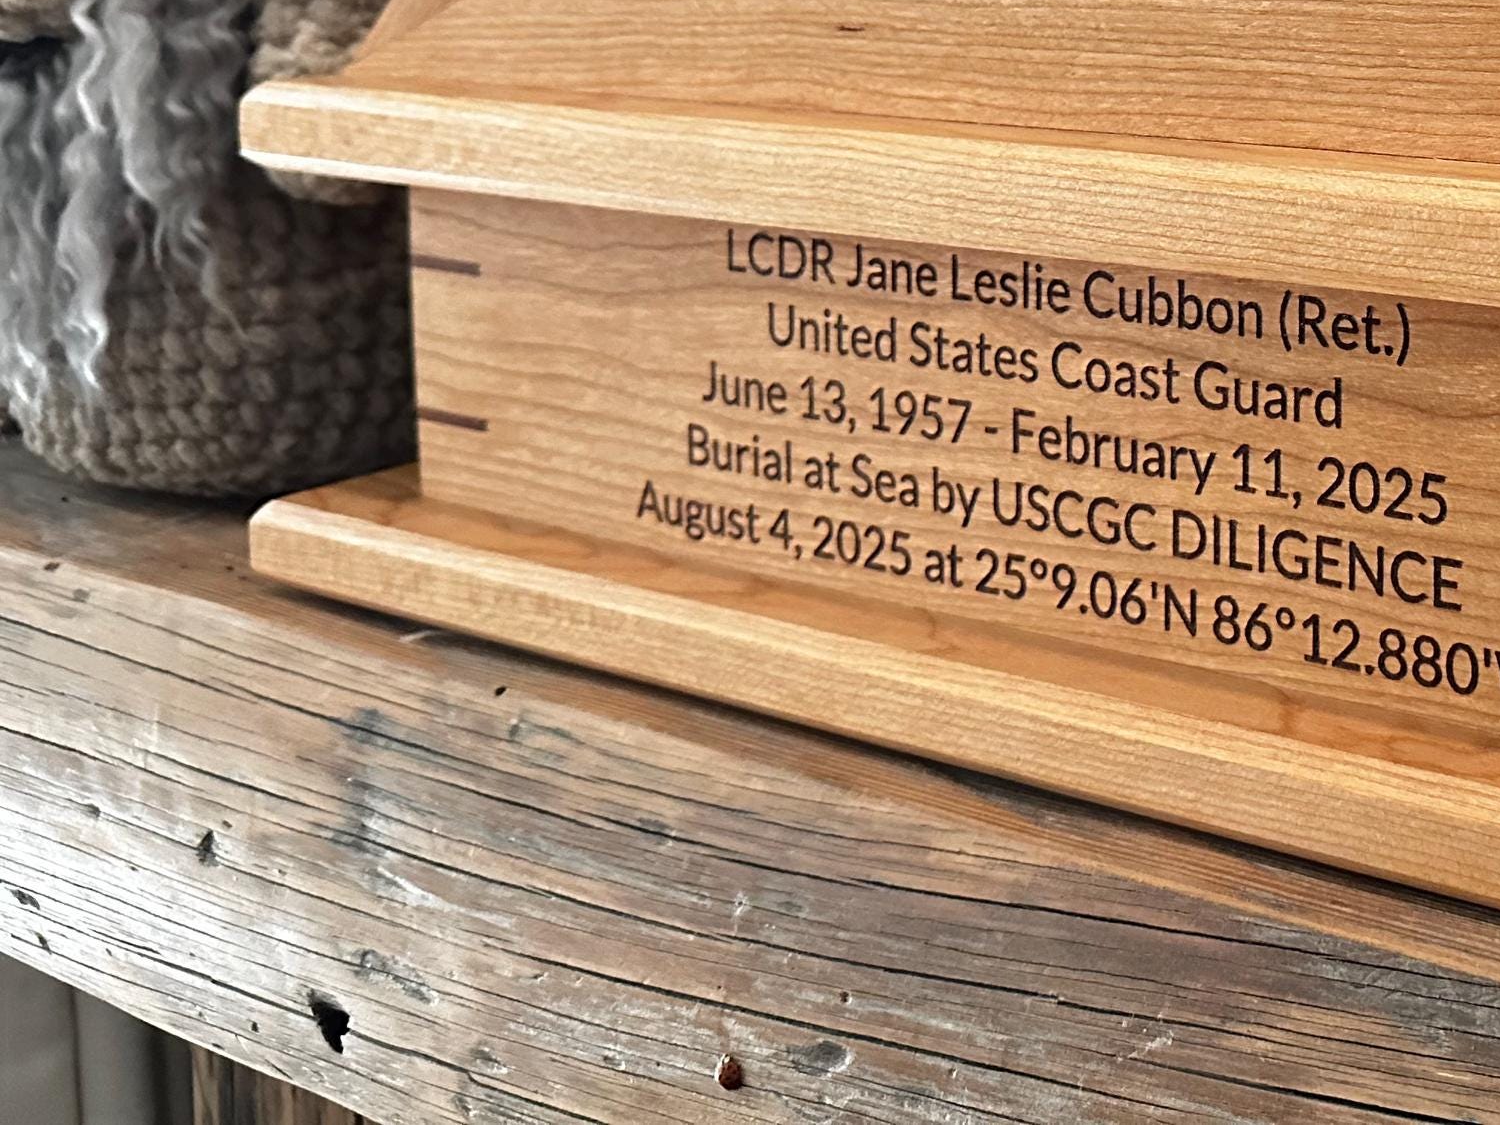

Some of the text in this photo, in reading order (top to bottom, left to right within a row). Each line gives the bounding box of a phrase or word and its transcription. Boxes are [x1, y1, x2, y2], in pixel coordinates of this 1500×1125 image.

[727, 228, 1411, 366] LCDR Jane Leslie Cubbon (Ret.)
[768, 302, 1343, 429] United States Coast Guard
[702, 360, 1447, 525] June 13, 1957 - February 11, 2025
[637, 480, 761, 544] August
[769, 509, 804, 560] 4,
[813, 516, 912, 575] 2025
[925, 544, 963, 587] at
[687, 423, 1463, 612] Burial at Sea by USCGC DILIGENCE
